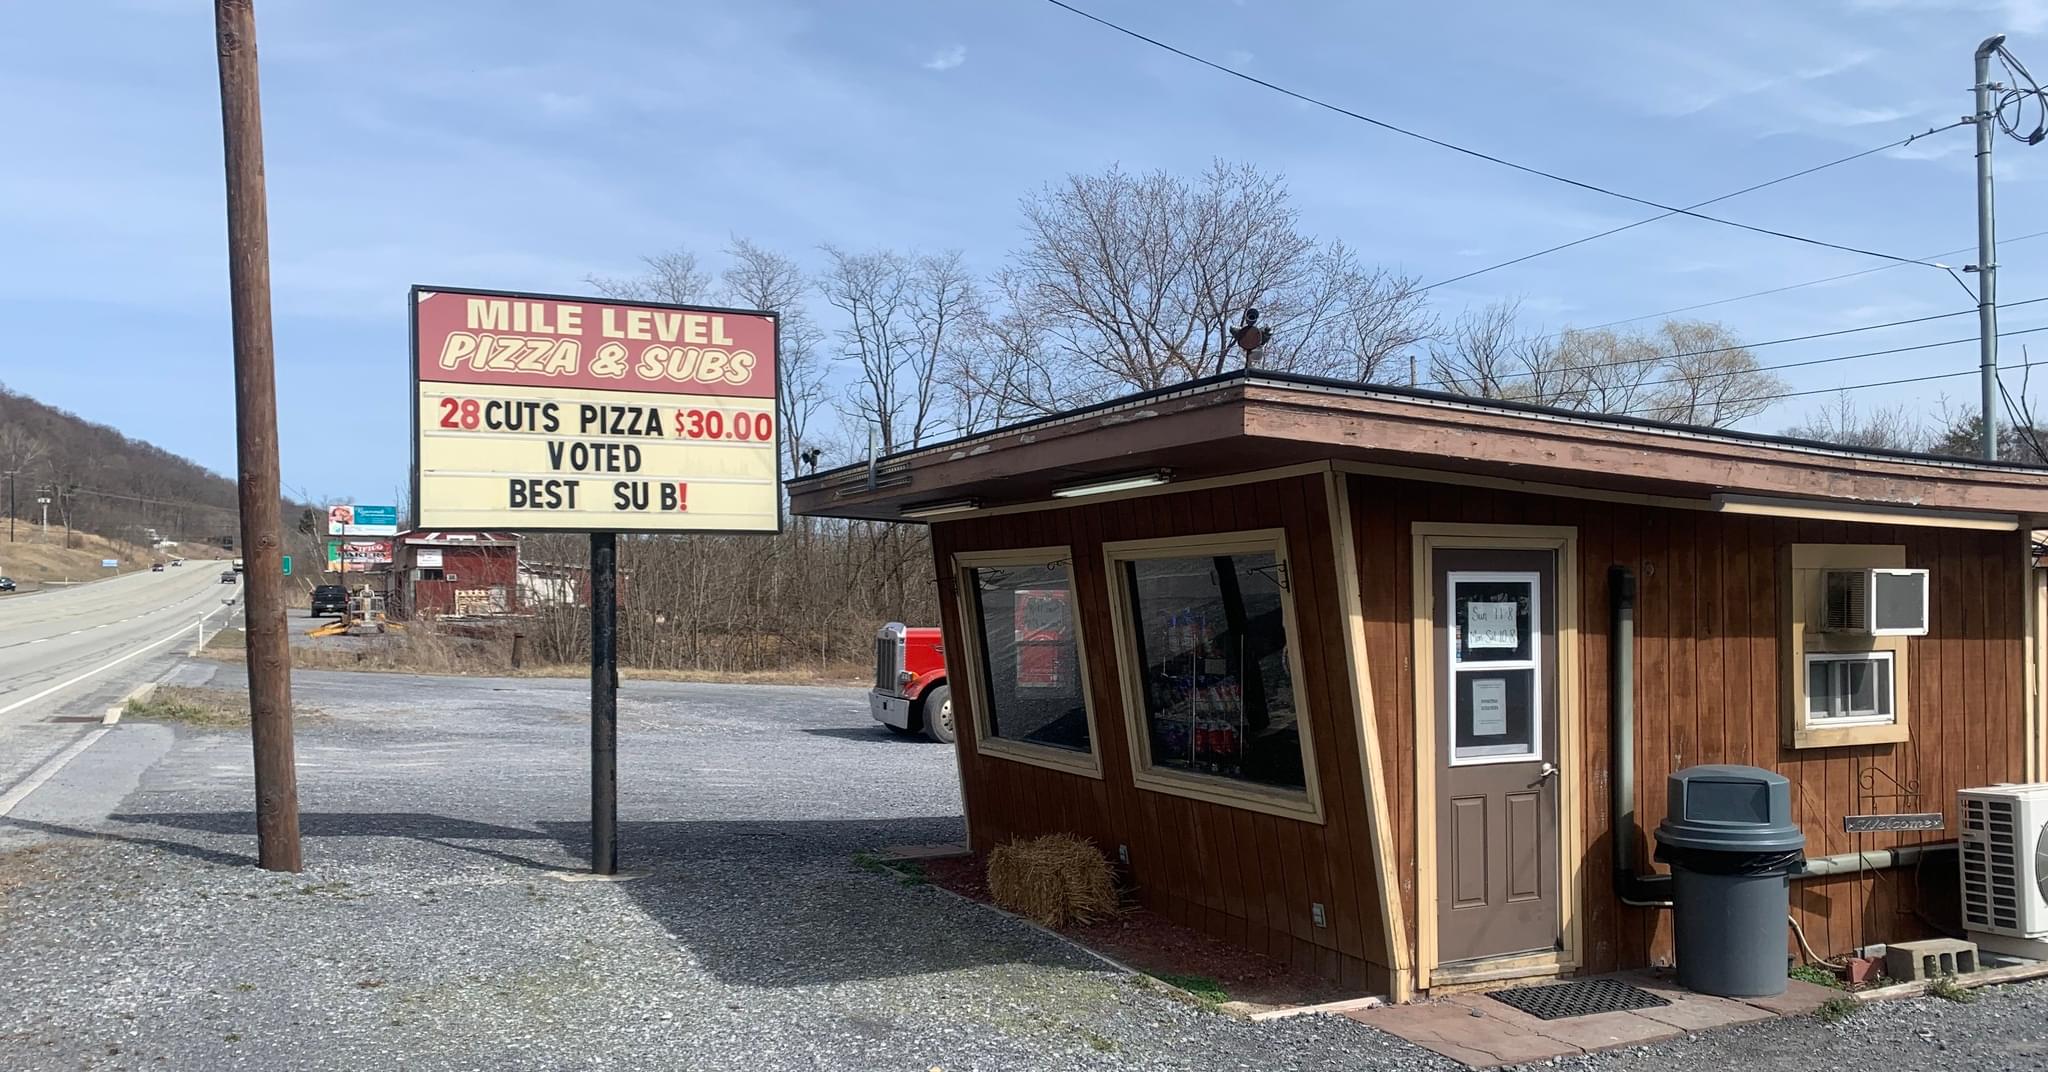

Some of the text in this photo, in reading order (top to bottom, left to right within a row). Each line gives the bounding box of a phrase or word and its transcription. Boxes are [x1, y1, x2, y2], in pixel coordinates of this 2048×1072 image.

[467, 298, 733, 346] MILE LEVEL
[439, 331, 756, 385] PIZZA & SUBS
[580, 404, 664, 436] PIZZA
[675, 409, 772, 441] $30.00
[547, 441, 641, 472] VOTED
[510, 479, 579, 508] BEST
[1857, 817, 1932, 830] Welcome
